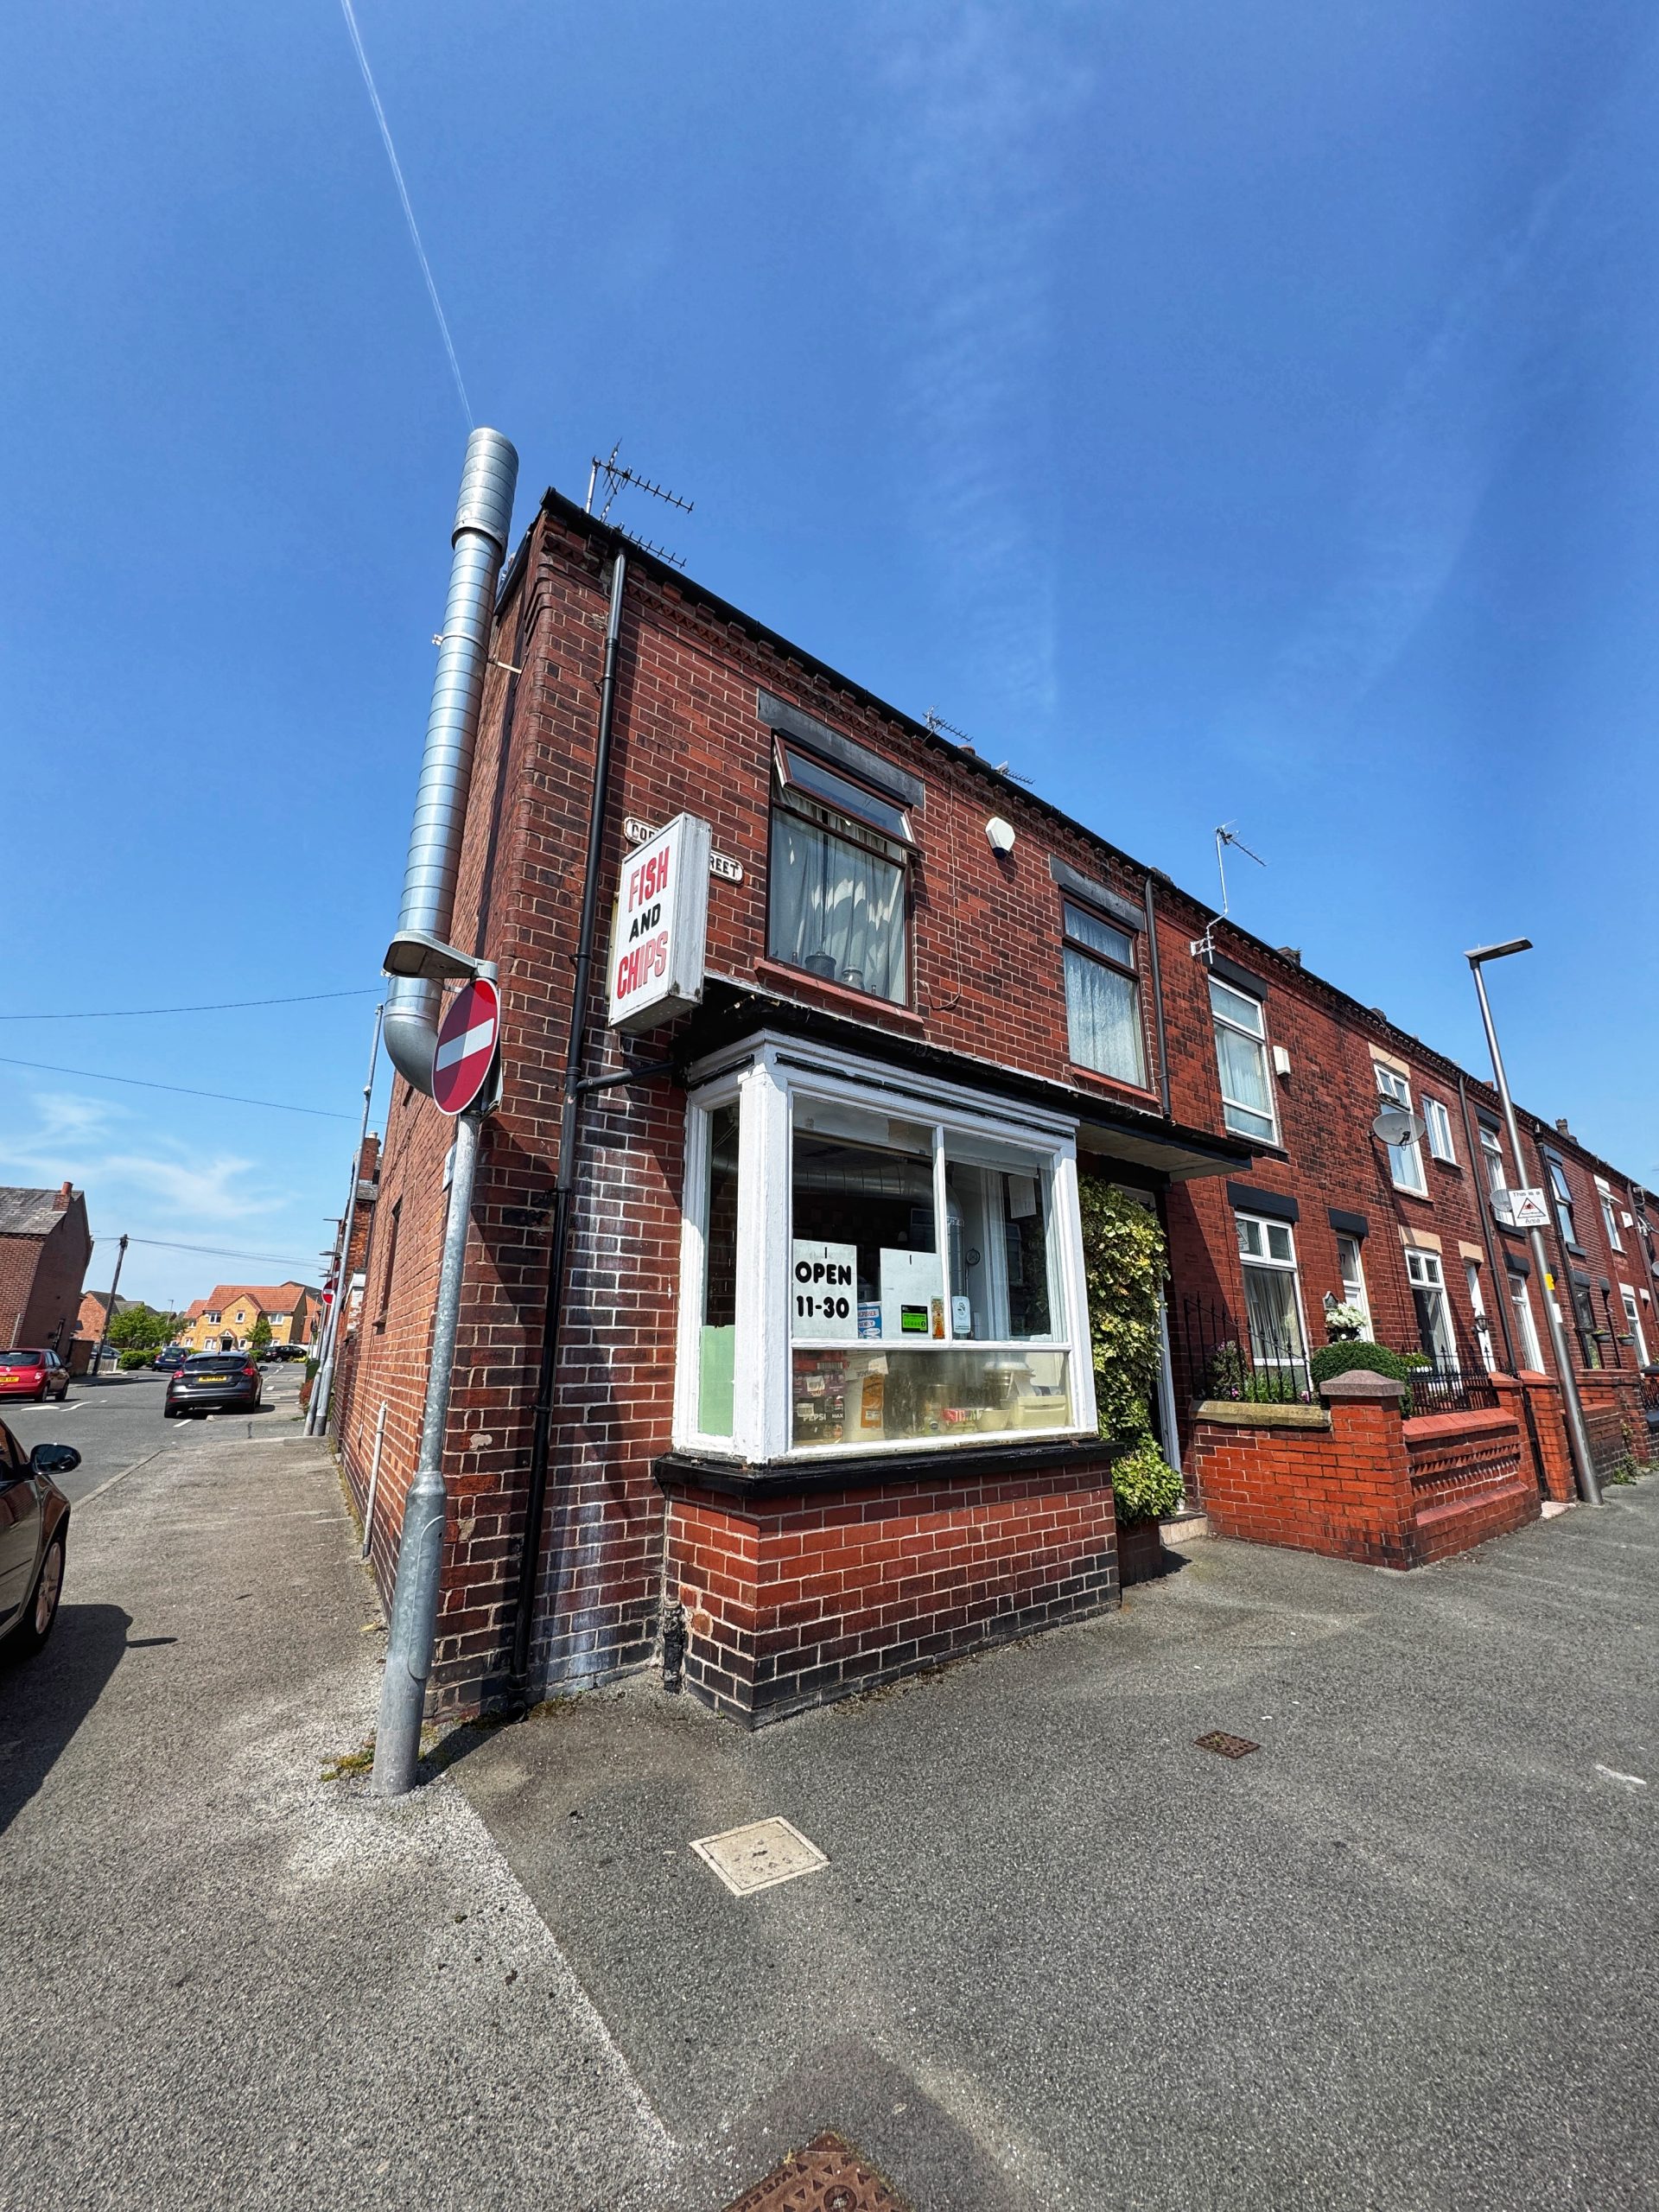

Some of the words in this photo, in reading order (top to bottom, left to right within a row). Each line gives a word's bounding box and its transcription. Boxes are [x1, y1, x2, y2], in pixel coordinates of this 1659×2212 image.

[628, 845, 670, 912] FISH
[710, 856, 738, 877] REET
[629, 903, 661, 943] AND
[617, 931, 669, 1000] CHIPS
[795, 1261, 852, 1286] OPEN
[796, 1295, 849, 1319] 11-30
